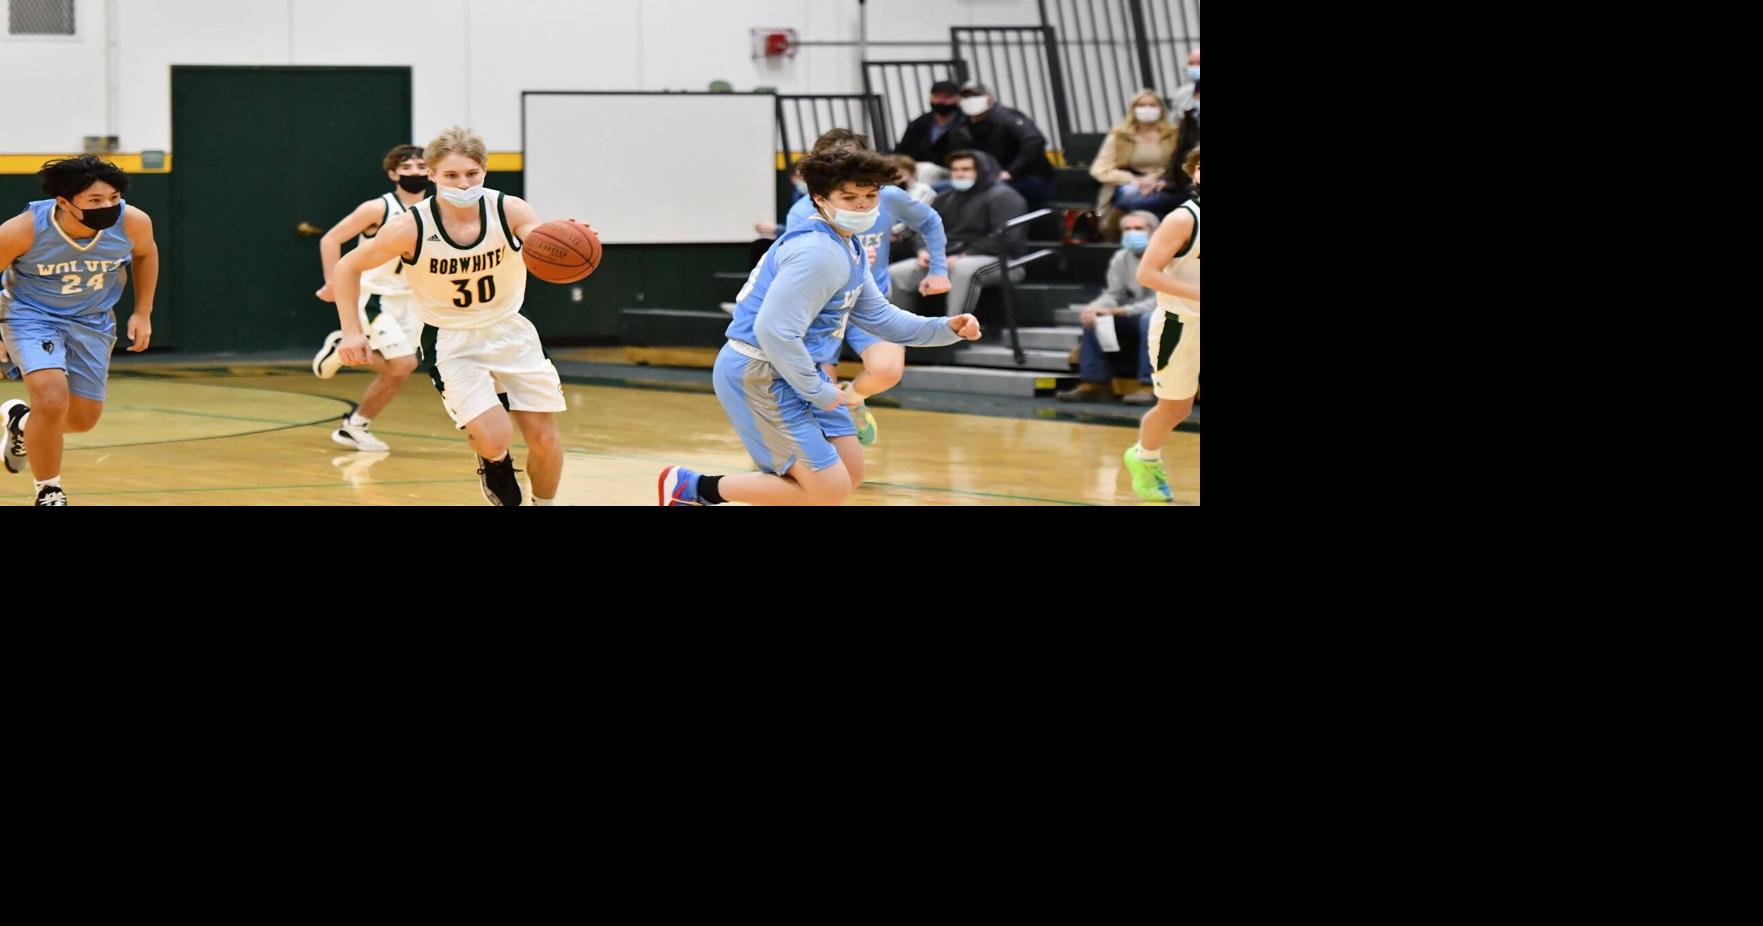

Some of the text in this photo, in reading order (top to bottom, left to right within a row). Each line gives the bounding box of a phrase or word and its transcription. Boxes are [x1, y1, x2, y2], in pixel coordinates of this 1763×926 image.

[430, 245, 505, 275] BOBWHITE
[61, 272, 105, 294] 24
[451, 275, 496, 308] 30
